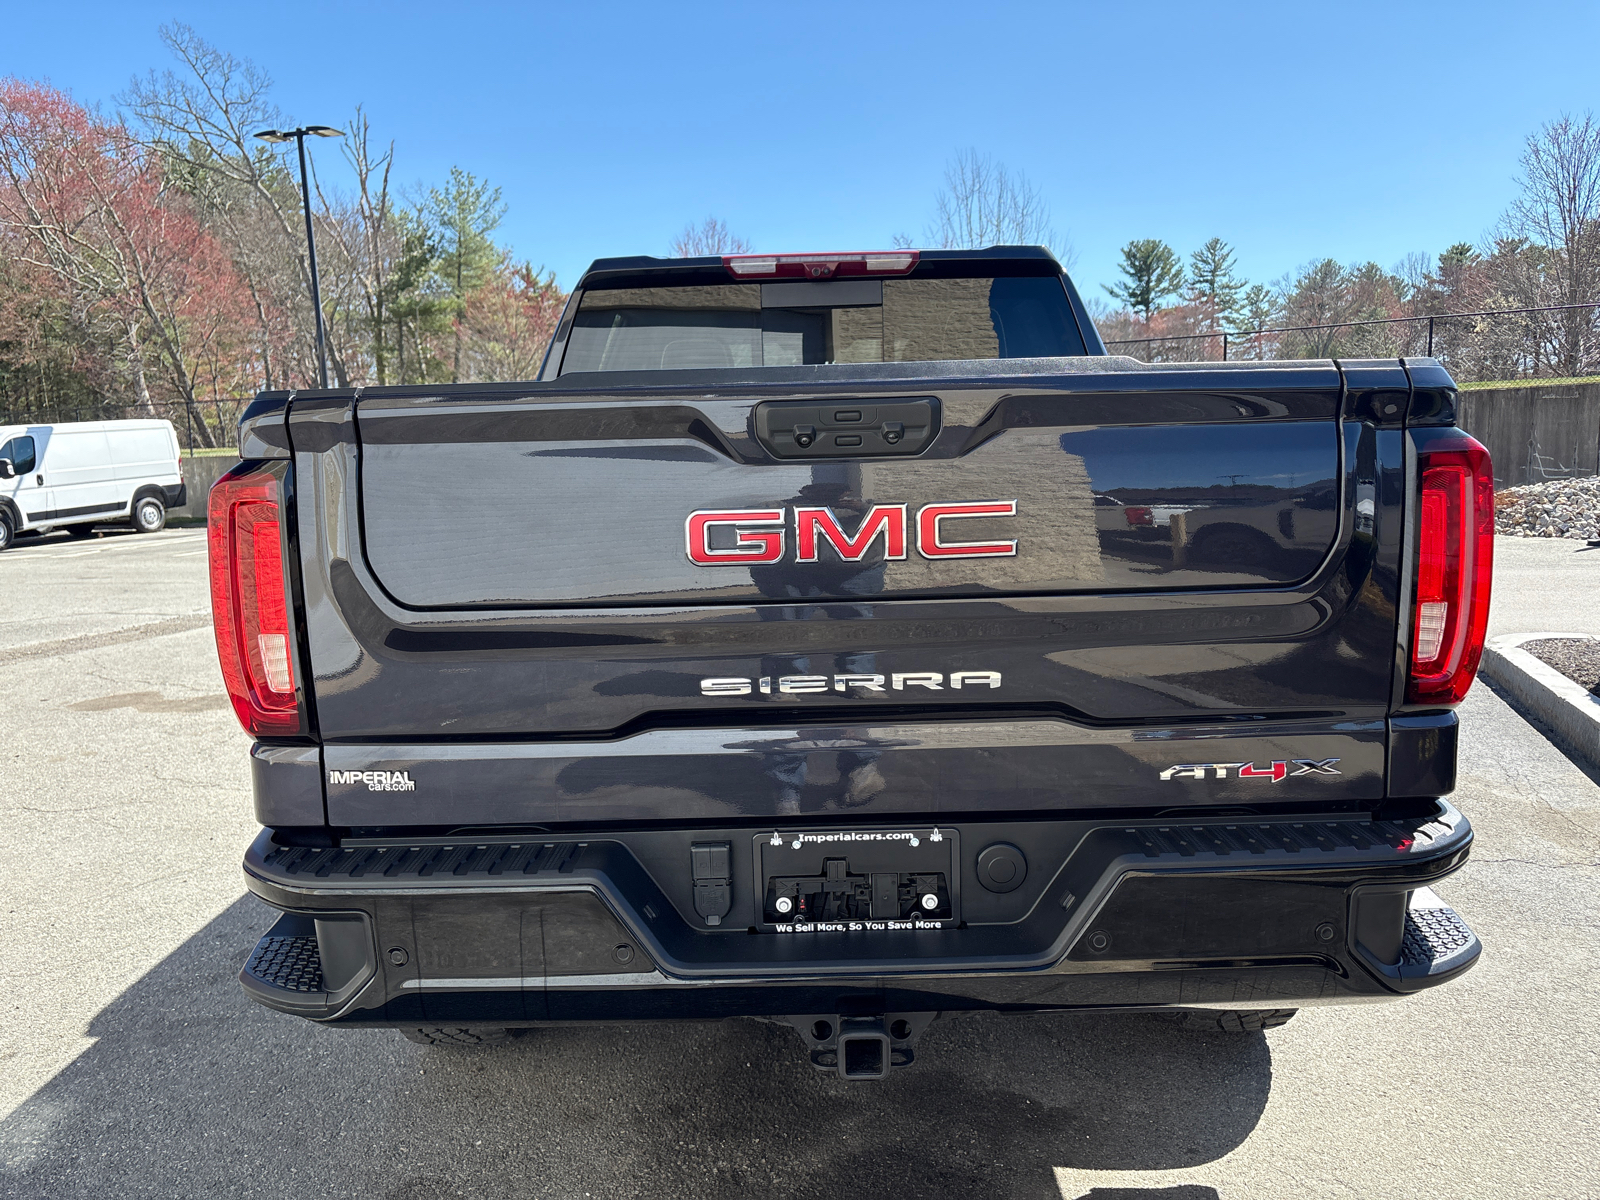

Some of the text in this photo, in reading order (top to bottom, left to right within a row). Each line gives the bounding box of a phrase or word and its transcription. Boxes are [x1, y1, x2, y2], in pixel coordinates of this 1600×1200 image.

[684, 499, 1018, 567] GMC
[700, 671, 1002, 697] SIERRA
[1159, 758, 1342, 783] AT4X
[329, 771, 415, 784] IMPERIAL
[368, 783, 415, 791] cars.com
[798, 833, 914, 843] Imperialcars.com
[795, 924, 814, 932] Sell
[817, 923, 846, 932] More,
[849, 922, 862, 931] So
[865, 922, 885, 930] You
[887, 921, 912, 930] Save
[915, 921, 942, 929] More
